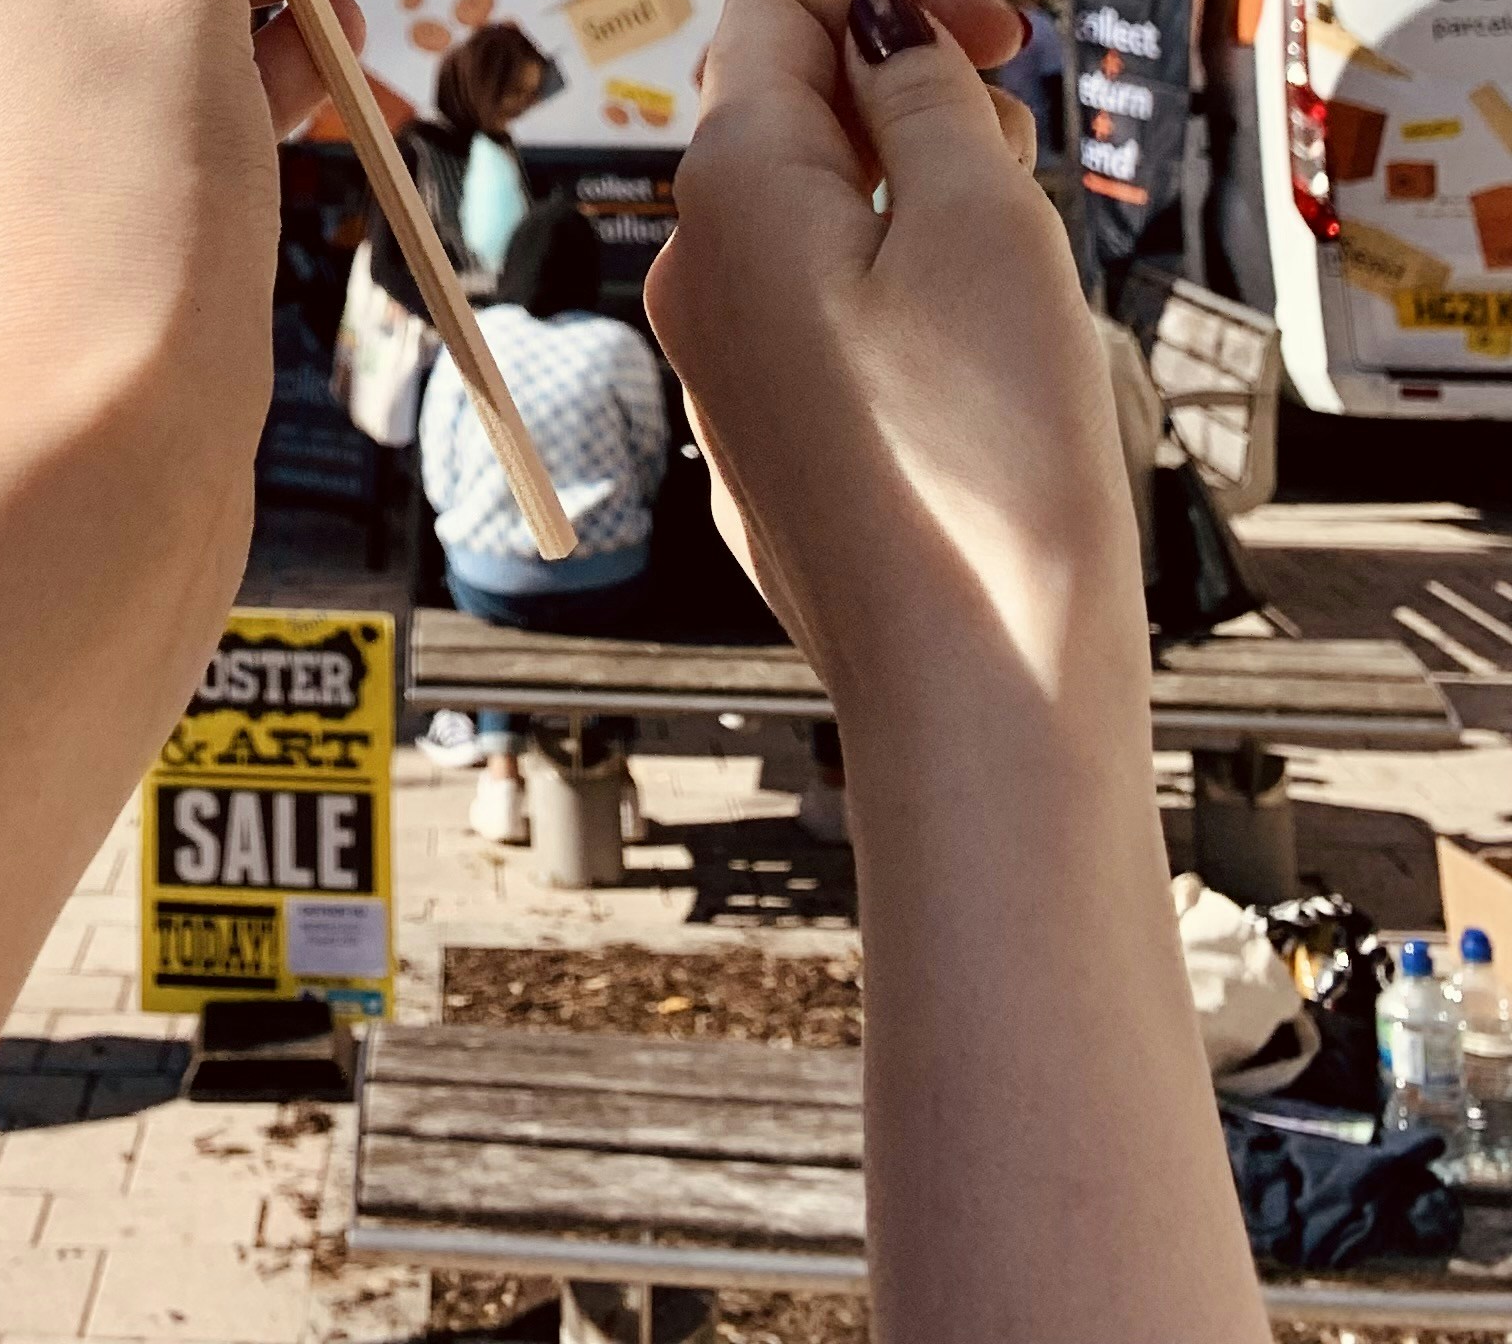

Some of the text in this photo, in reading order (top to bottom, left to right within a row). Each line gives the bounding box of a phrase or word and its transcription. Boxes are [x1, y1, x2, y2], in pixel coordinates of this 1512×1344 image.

[1077, 69, 1155, 121] eturn
[196, 648, 358, 708] OSTER
[212, 727, 372, 769] ART
[172, 789, 359, 891] SALE
